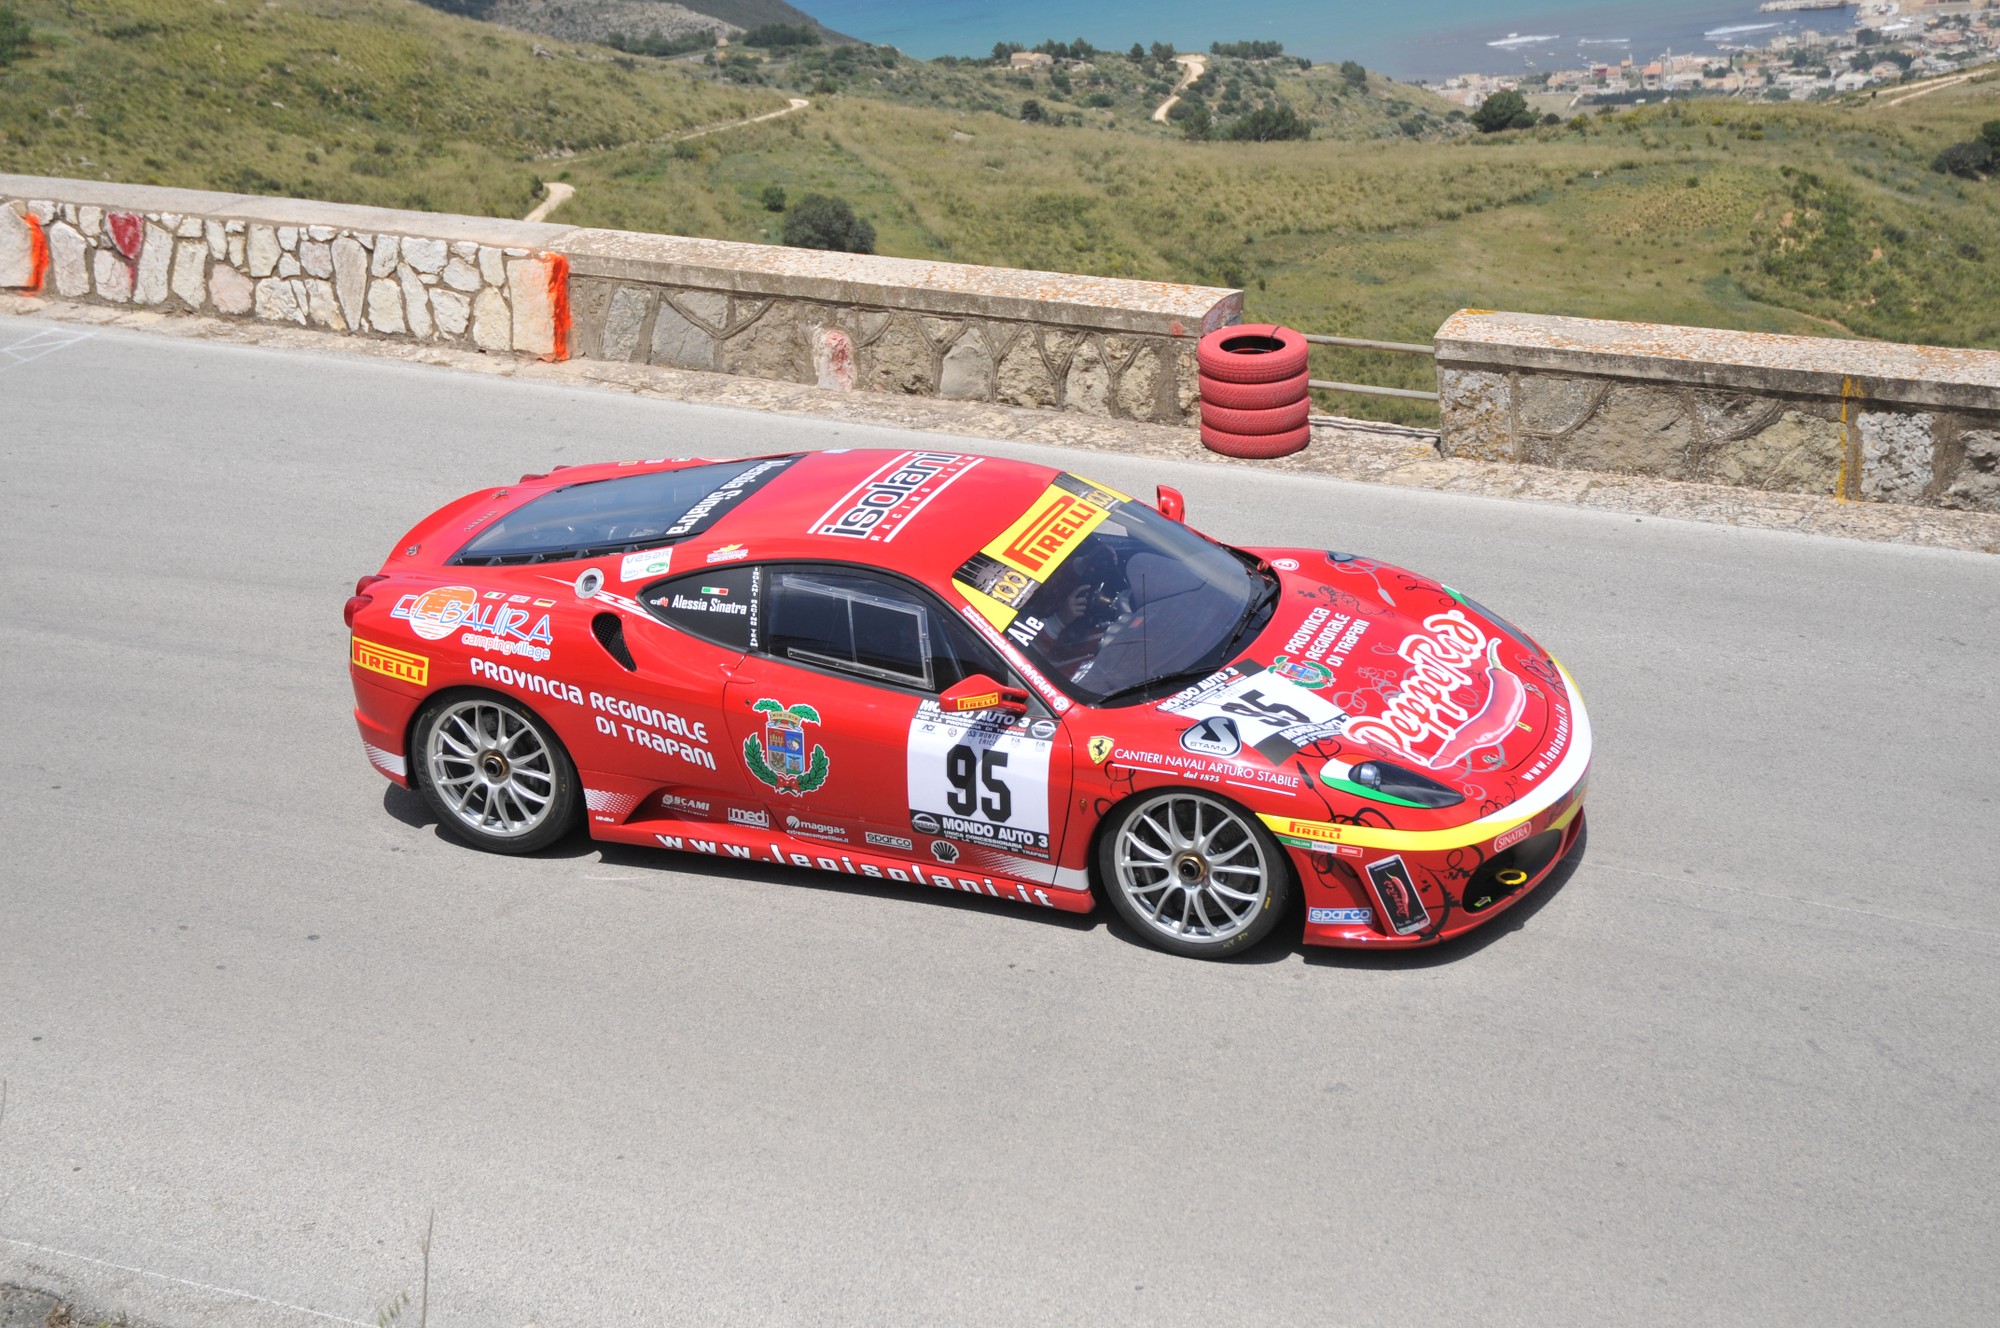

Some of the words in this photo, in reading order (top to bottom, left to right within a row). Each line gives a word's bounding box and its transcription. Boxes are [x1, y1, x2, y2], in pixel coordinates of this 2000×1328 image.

[818, 451, 963, 540] isolani
[1002, 495, 1098, 573] PIRELLI
[671, 594, 708, 611] Alessia
[709, 597, 748, 615] Sinatra
[390, 594, 553, 645] EL-BAHIRA
[1007, 616, 1045, 648] Ale
[461, 632, 551, 661] campingvillage
[354, 639, 427, 682] PIRELLI
[1325, 654, 1344, 667] DI
[1198, 671, 1229, 690] AUTO
[1225, 667, 1239, 676] 3
[959, 693, 998, 710] PIRELLI
[595, 716, 618, 737] DI
[976, 710, 1015, 725] AUTO
[1018, 717, 1031, 728] 3
[1189, 741, 1228, 752] STAMA
[1114, 749, 1162, 764] CANTIERI
[1165, 755, 1205, 771] NAVALI
[1207, 763, 1254, 779] ARTURO
[1257, 770, 1299, 788] STABILE
[1183, 771, 1197, 779] dal
[1199, 773, 1220, 783] 1875
[946, 743, 1011, 823] 95
[732, 808, 765, 824] med
[800, 821, 846, 835] magigas
[943, 817, 994, 837] MONDO
[998, 827, 1034, 845] AUTO
[1038, 835, 1048, 848] 3
[1289, 821, 1342, 839] PIRELLI
[1497, 826, 1528, 850] SINATRA
[866, 833, 911, 848] sparco
[1311, 909, 1370, 922] sparco
